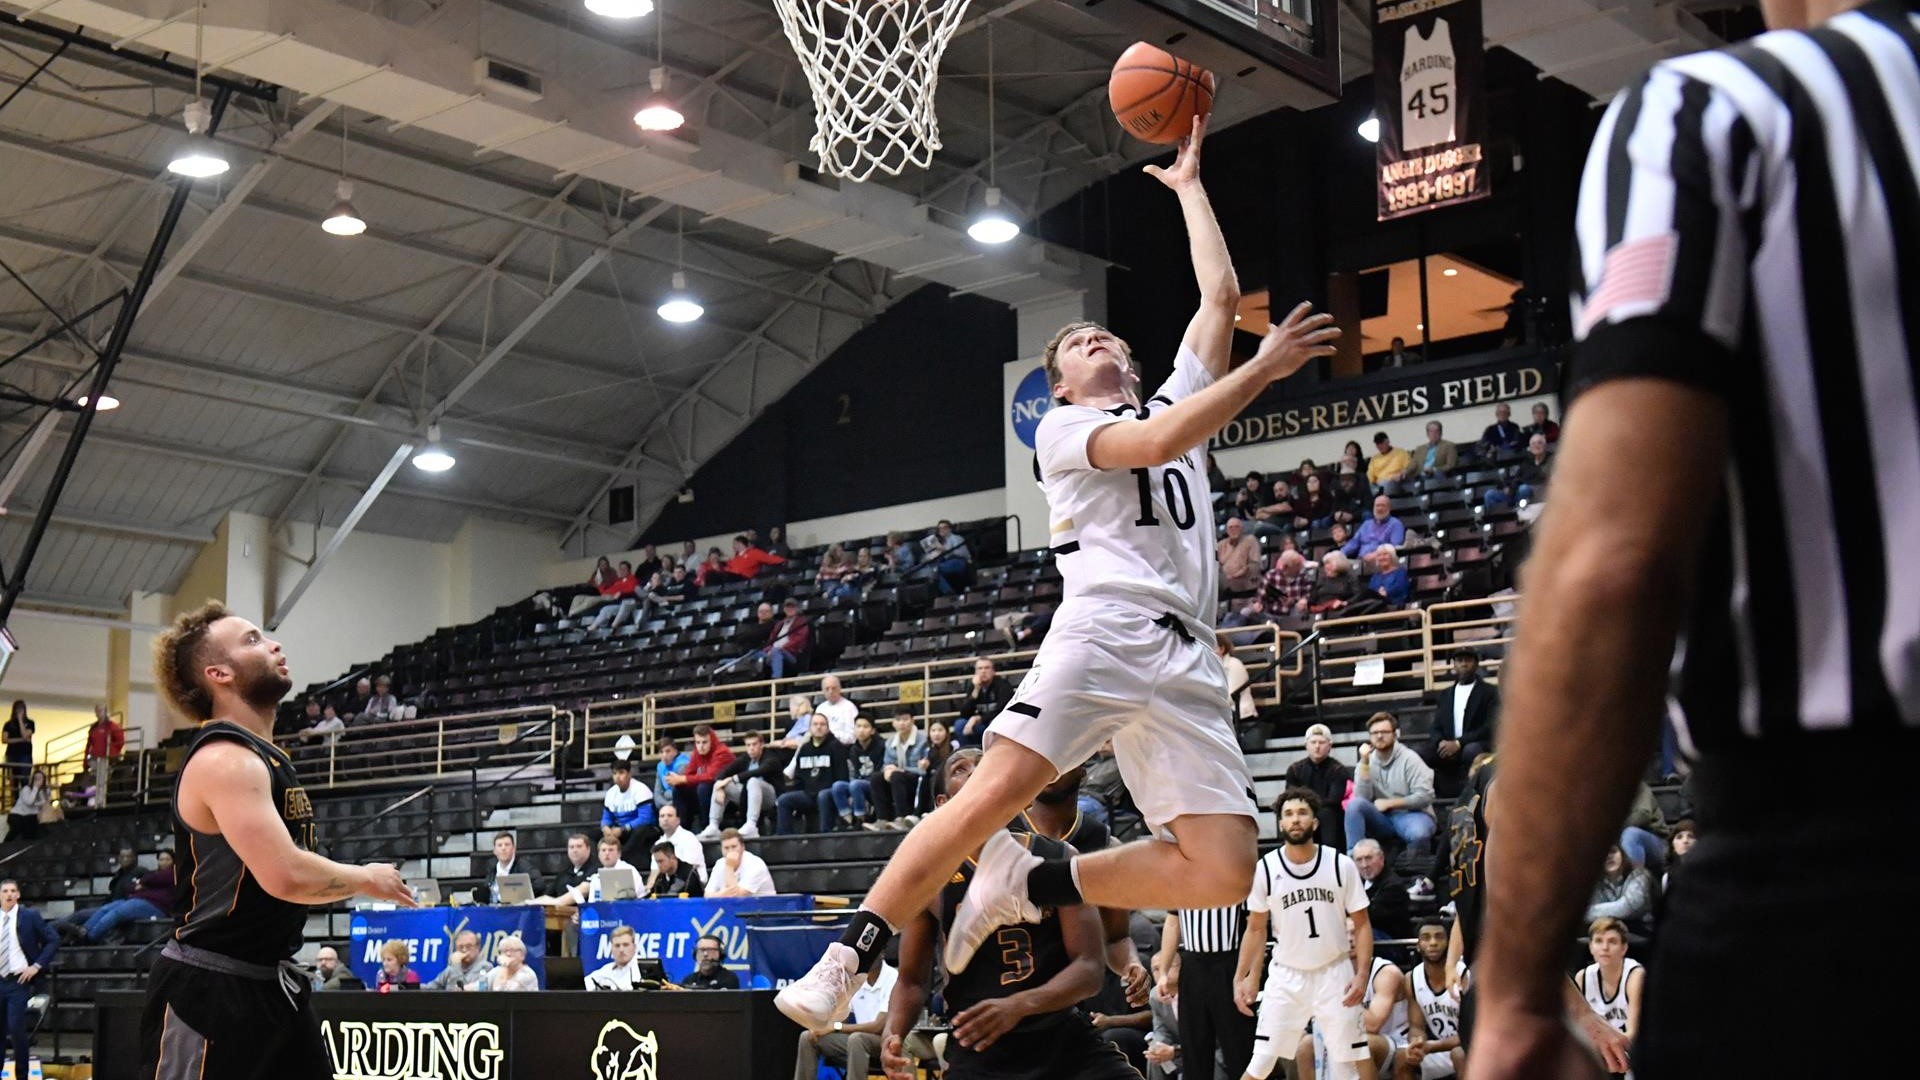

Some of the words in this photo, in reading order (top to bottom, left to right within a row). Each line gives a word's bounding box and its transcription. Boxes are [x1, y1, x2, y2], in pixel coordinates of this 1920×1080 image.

[1404, 54, 1454, 81] HARDING
[1408, 82, 1450, 119] 45
[1387, 168, 1476, 211] 1993-1997
[1206, 385, 1429, 449] HODES-REAVES
[1442, 367, 1543, 408] FIELD
[1131, 467, 1196, 530] 10
[1281, 887, 1335, 910] HARDING
[1304, 906, 1320, 939] 1
[363, 938, 419, 963] ME
[422, 938, 442, 963] IT
[596, 932, 661, 960] MKE
[665, 932, 690, 959] IT
[997, 928, 1035, 986] 3
[321, 1020, 504, 1080] ARDING
